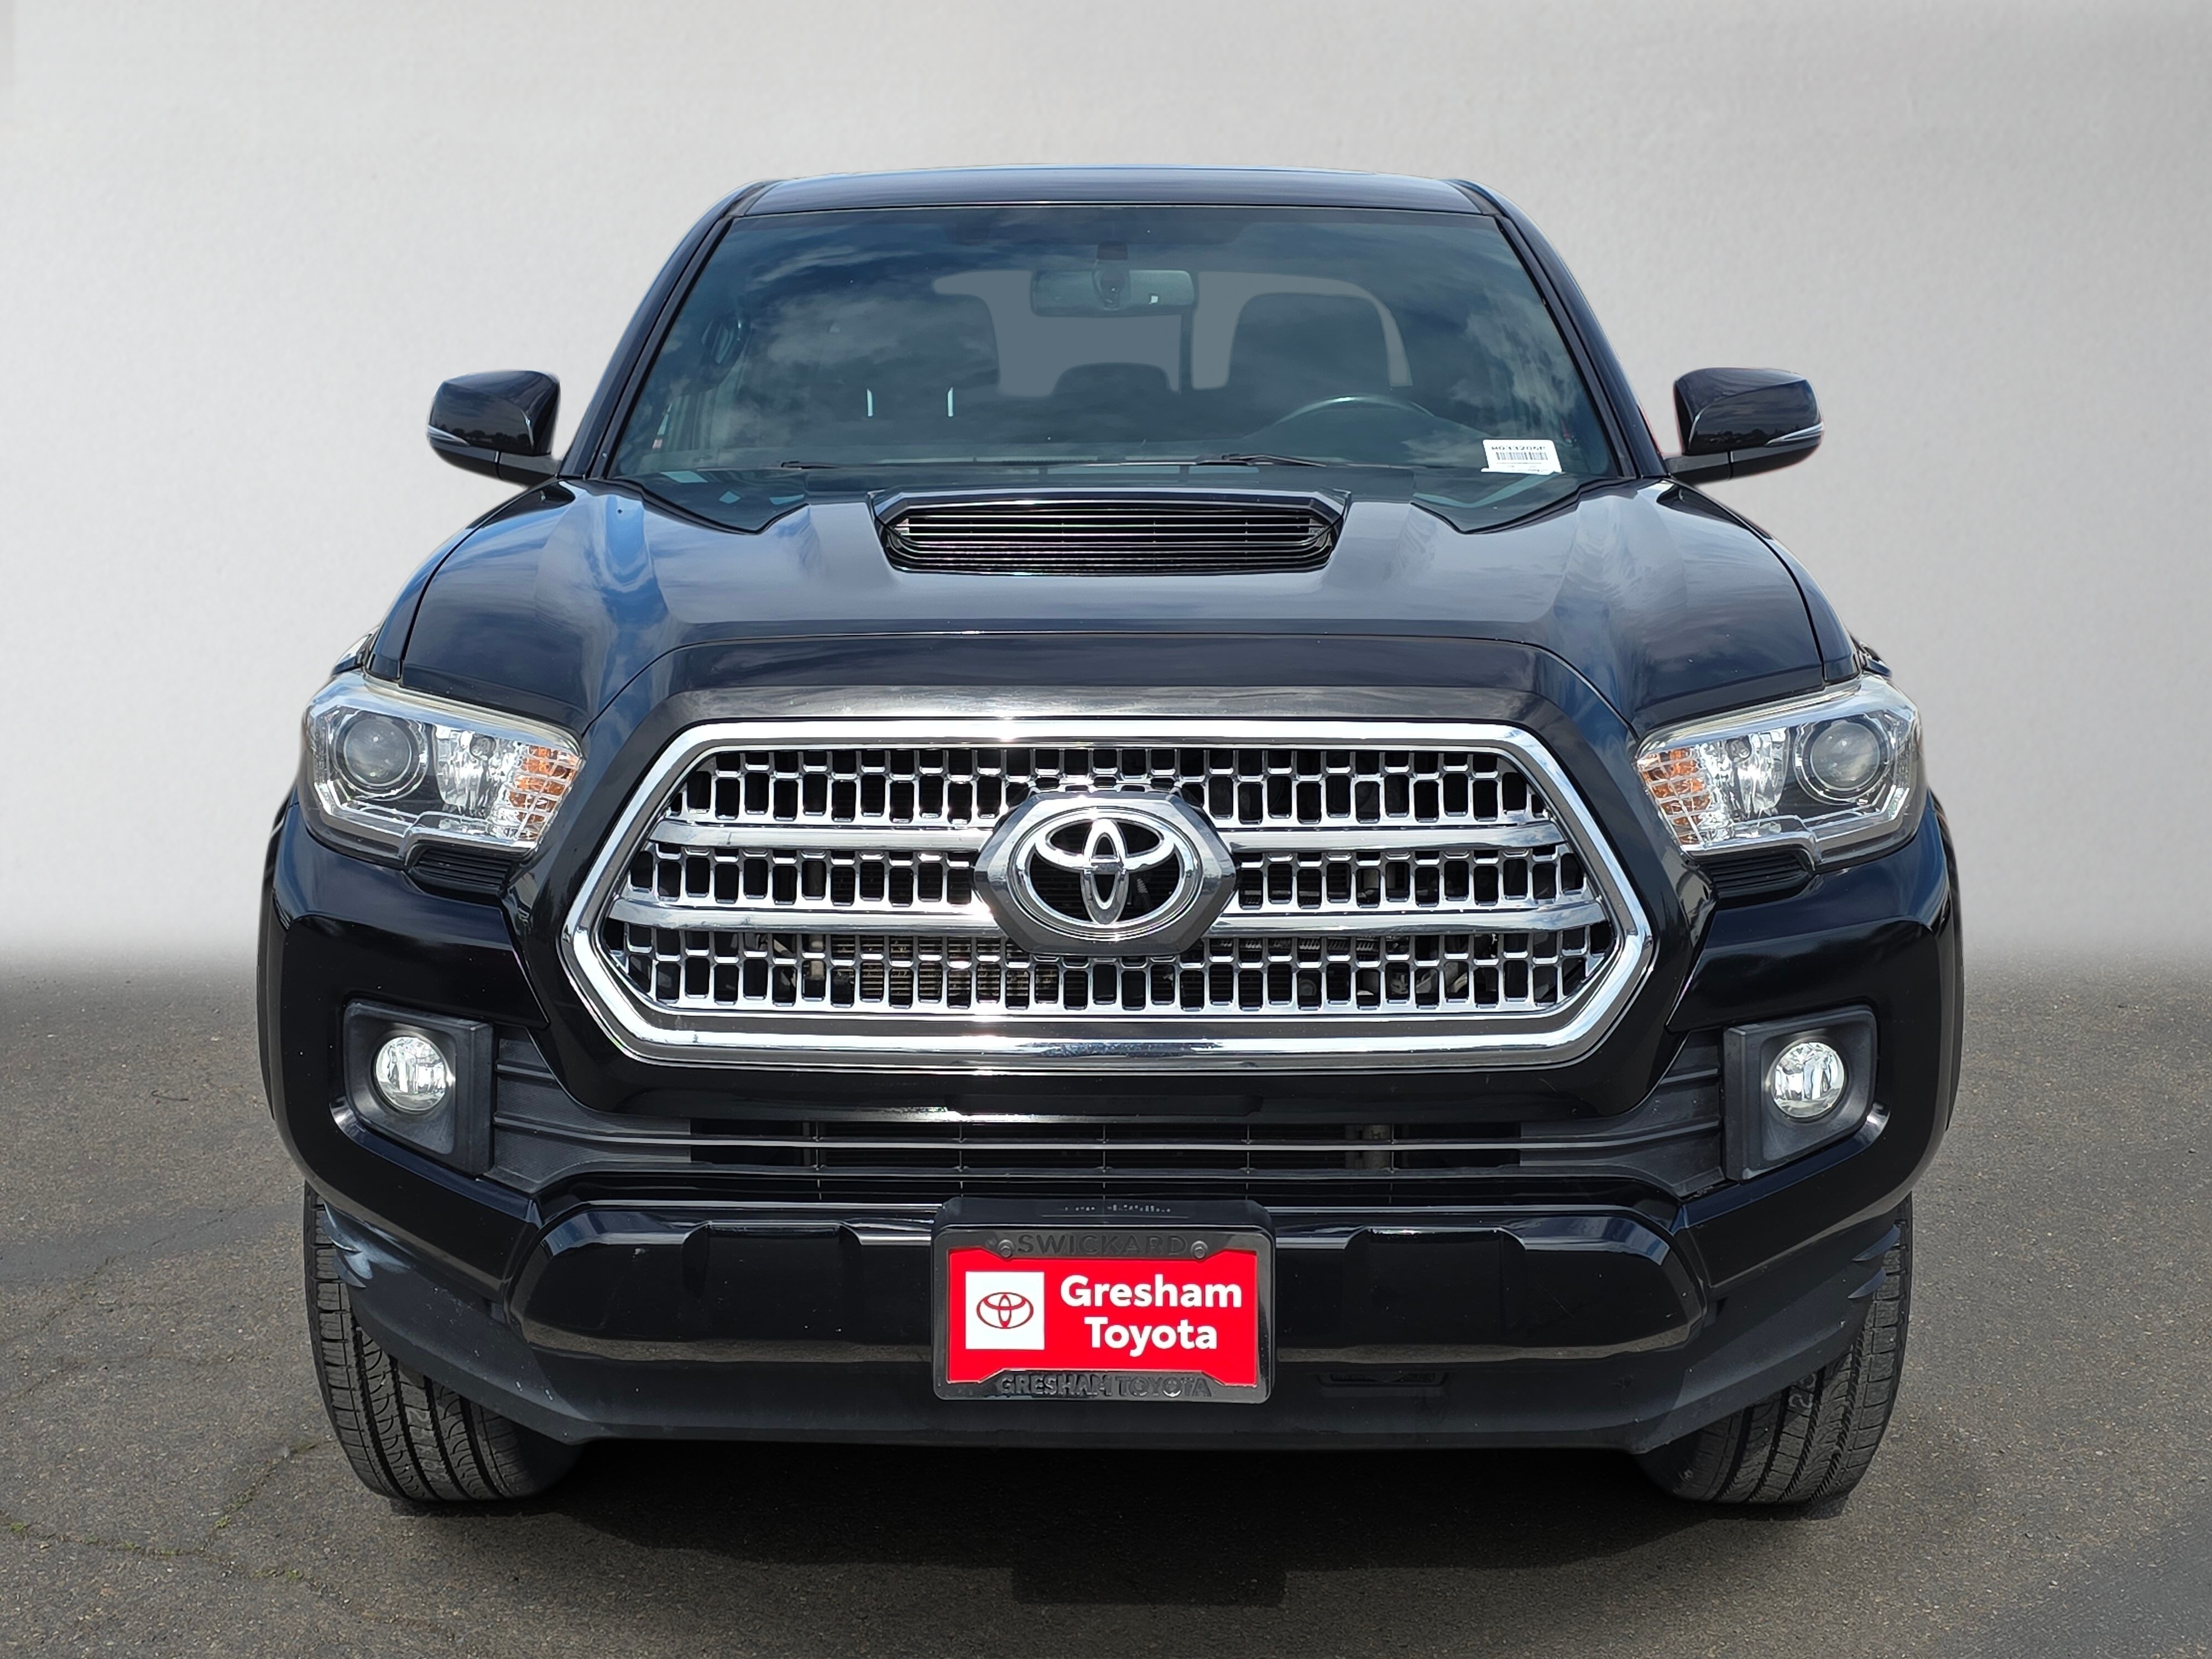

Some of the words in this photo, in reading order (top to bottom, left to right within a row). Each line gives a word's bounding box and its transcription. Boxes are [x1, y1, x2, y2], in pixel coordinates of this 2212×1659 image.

[1017, 1234, 1187, 1255] SWICKARD
[1061, 1274, 1241, 1307] Gresham
[1084, 1317, 1217, 1357] Toyota
[998, 1374, 1112, 1397] GRESHAM
[1115, 1375, 1212, 1397] TOYOTA
